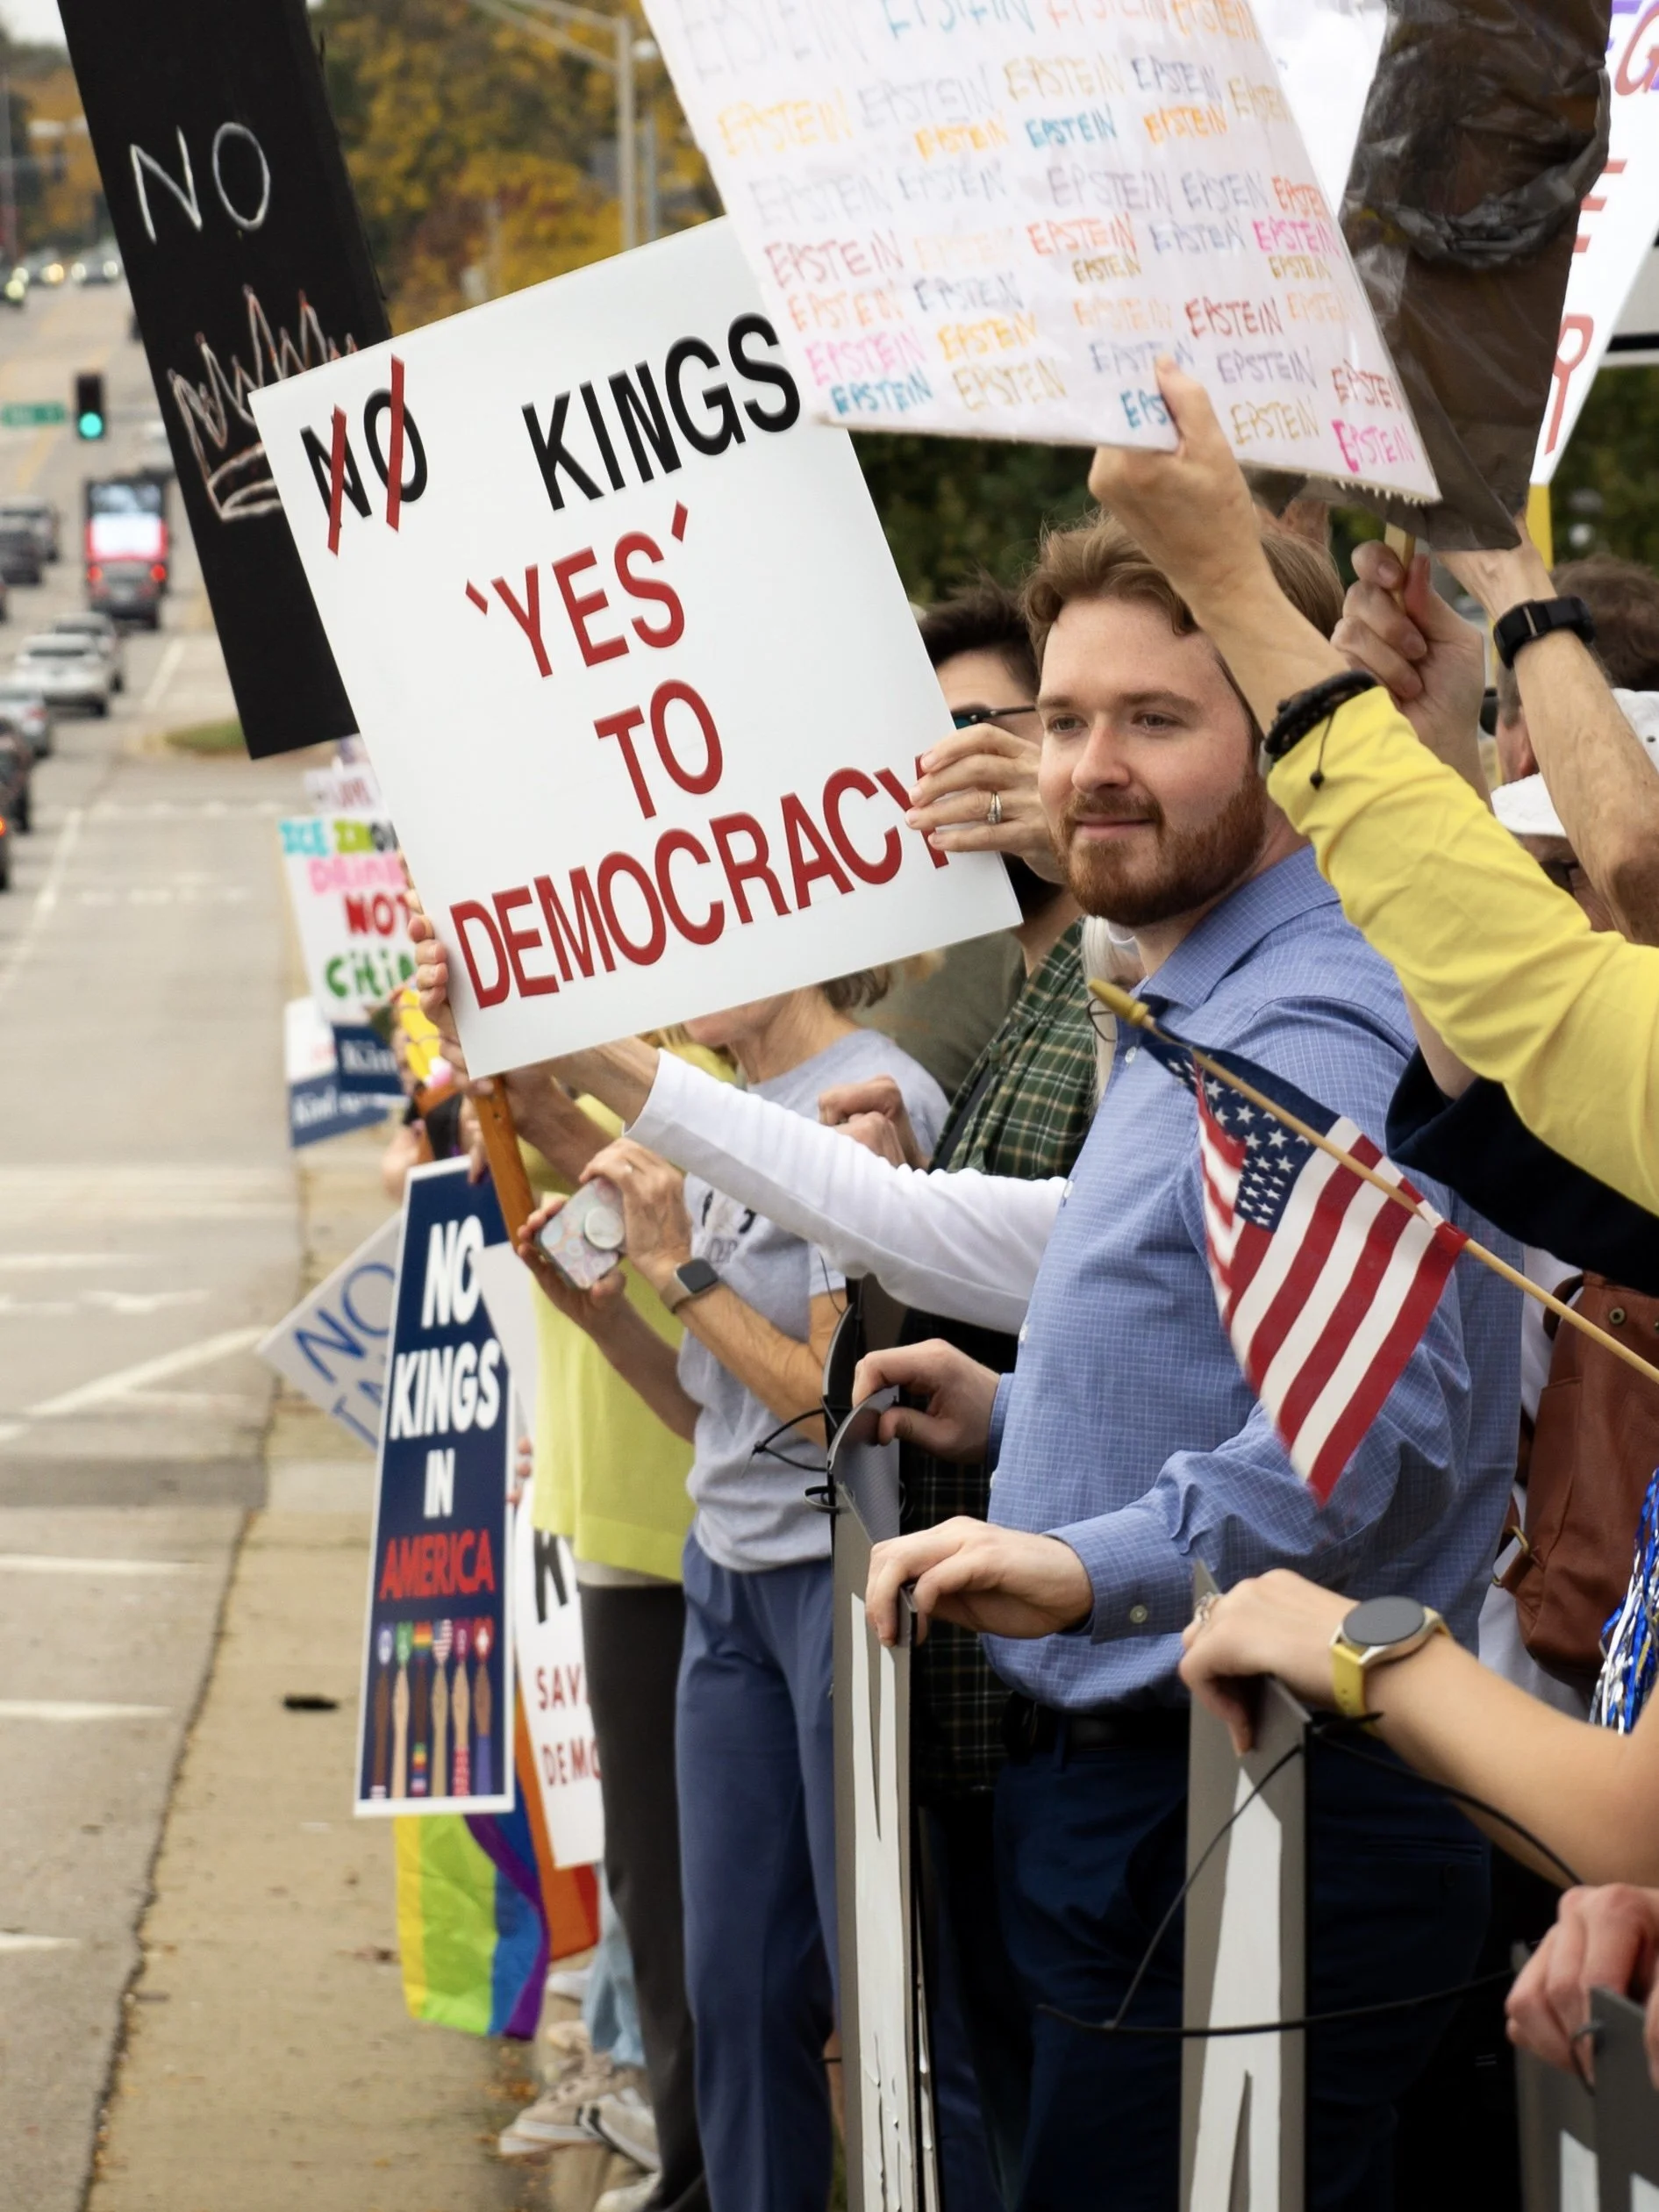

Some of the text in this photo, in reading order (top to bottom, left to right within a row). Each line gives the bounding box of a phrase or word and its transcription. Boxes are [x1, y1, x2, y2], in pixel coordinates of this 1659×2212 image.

[129, 122, 270, 244] NO
[763, 226, 905, 290] EPSTEIN
[1026, 211, 1138, 257] EPSTEIN
[1252, 214, 1343, 261] EPSTEIN
[804, 325, 928, 388] EPSTEIN
[1216, 345, 1319, 392] EPSTEIN
[1183, 295, 1284, 340] EPSTEIN
[300, 313, 801, 521] NO KINGS
[829, 367, 933, 417] EPSTEIN
[1230, 396, 1320, 447] EPSTEIN
[594, 678, 724, 820] TO
[449, 756, 950, 1011] DEMOCRACY
[421, 1214, 485, 1329] NO
[389, 1337, 502, 1441] KINGS
[423, 1447, 455, 1519] IN
[379, 1528, 495, 1601] AMERICA
